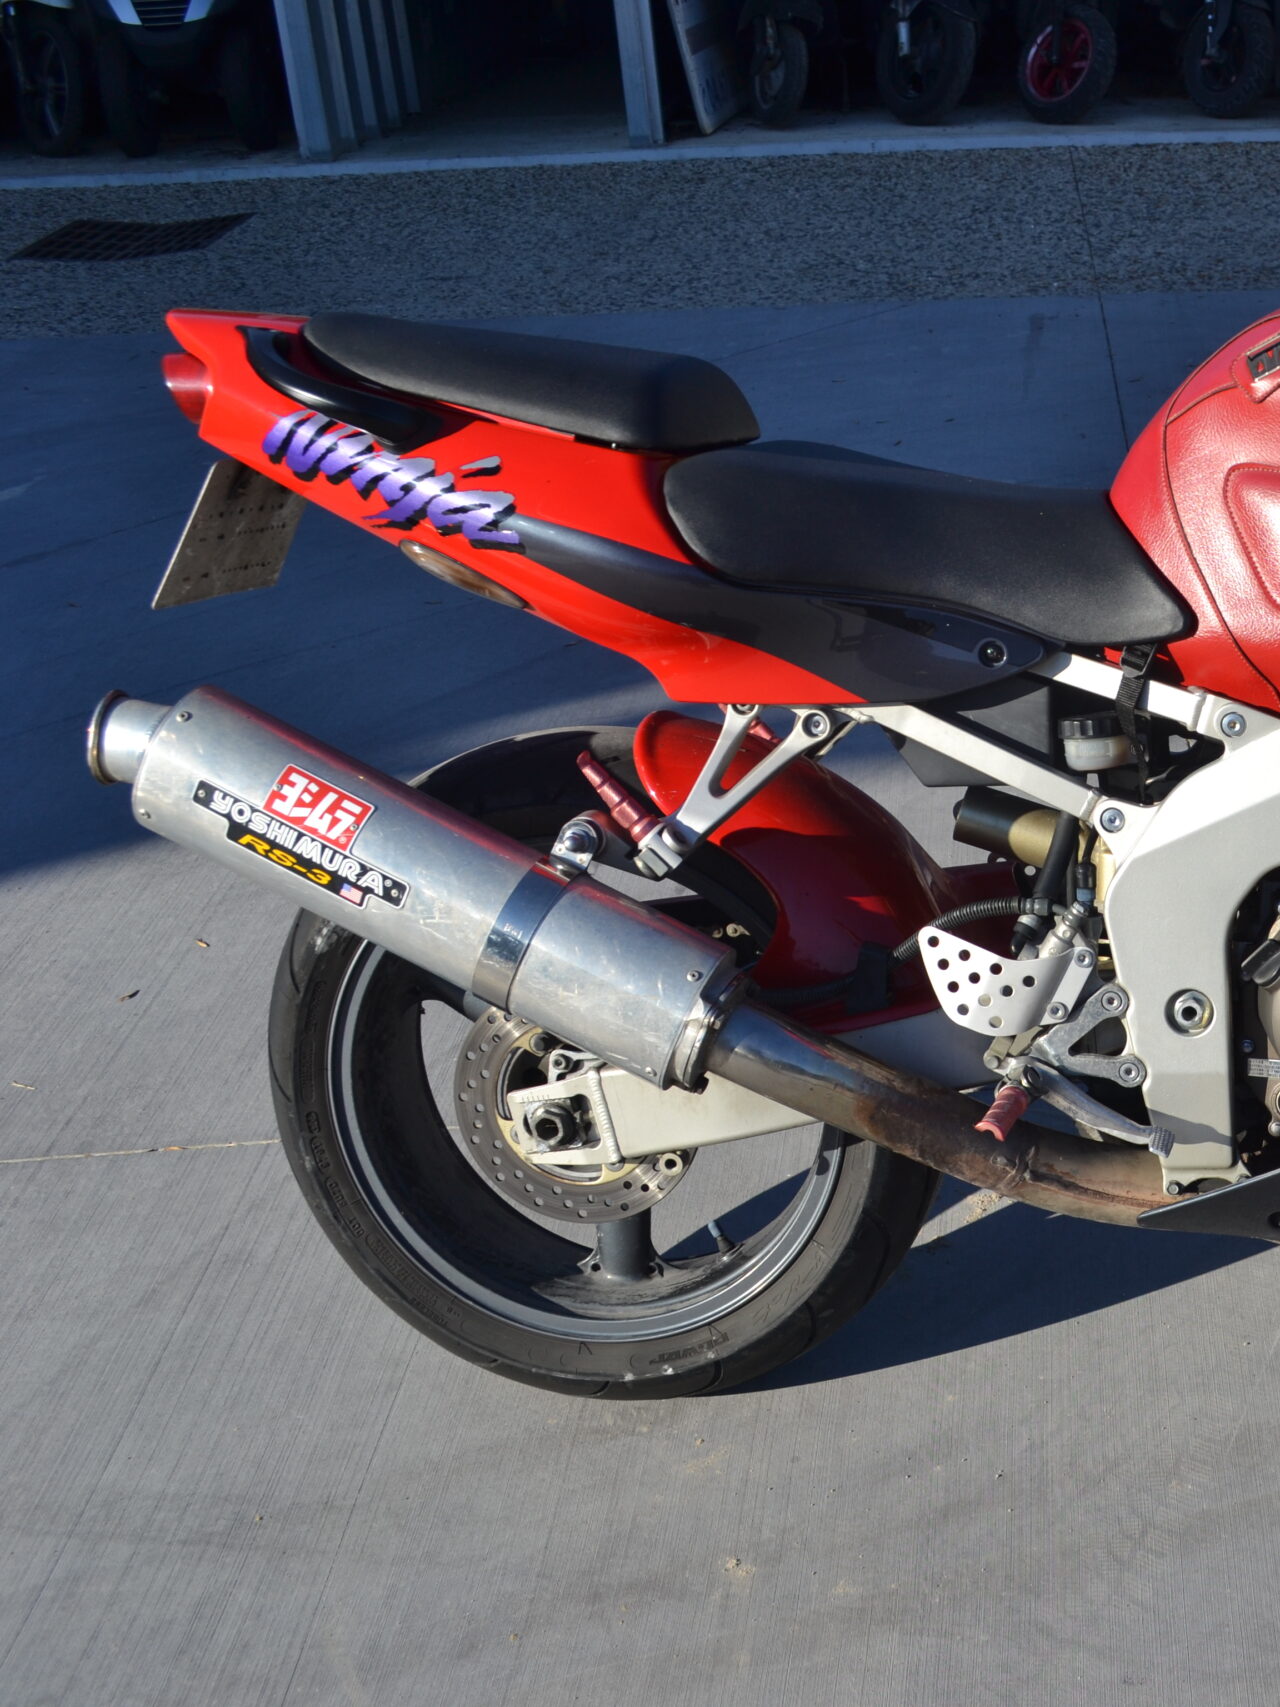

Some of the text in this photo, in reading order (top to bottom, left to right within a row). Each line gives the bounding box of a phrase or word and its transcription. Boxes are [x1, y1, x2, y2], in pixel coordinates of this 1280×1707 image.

[262, 409, 521, 547] Ninja
[209, 790, 385, 897] YOSHIMURA
[237, 833, 333, 886] RS-3
